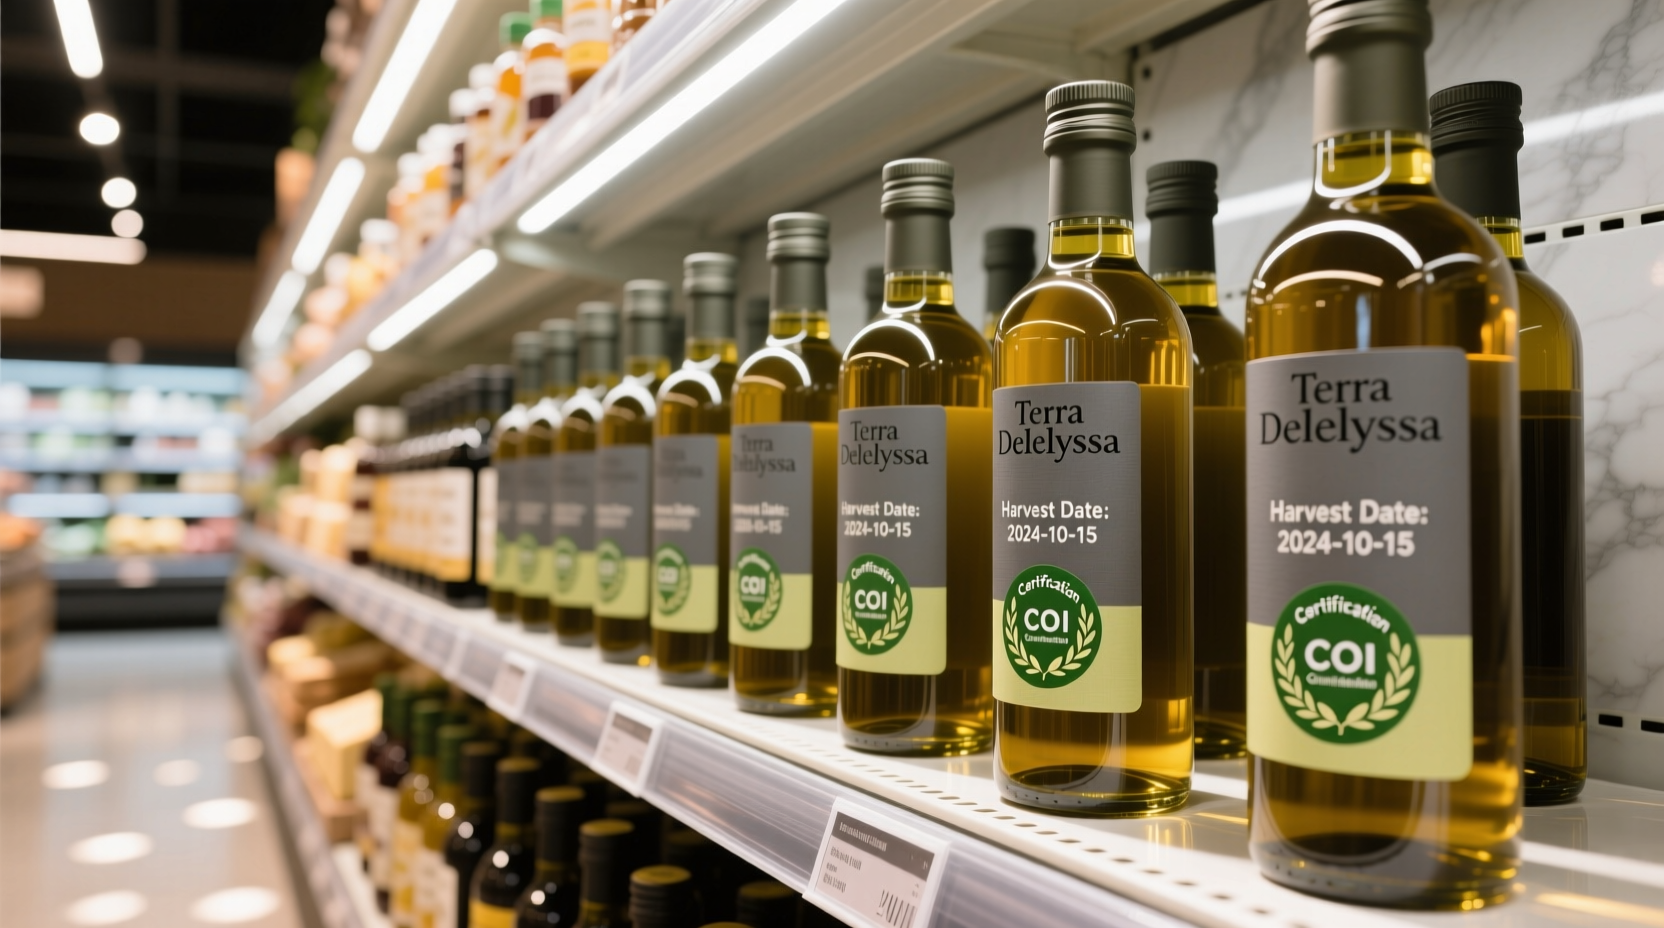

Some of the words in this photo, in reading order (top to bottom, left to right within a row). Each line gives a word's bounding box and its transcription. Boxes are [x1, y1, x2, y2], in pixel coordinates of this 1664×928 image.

[1291, 372, 1392, 405] Terra
[1014, 399, 1085, 426] Terra
[850, 420, 899, 442] Terra
[1260, 406, 1442, 454] Delelyssa
[841, 443, 929, 472] Delelyssa
[999, 427, 1121, 463] Delelyssa
[841, 501, 879, 516] Harvest
[883, 501, 920, 518] Date:
[1001, 500, 1055, 518] Harvest
[1061, 500, 1109, 520] Date:
[1270, 499, 1352, 524] Harvest
[1359, 499, 1429, 525] Date:
[843, 520, 912, 538] 2024-10-15
[1007, 524, 1098, 544] 2024-10-15
[1277, 529, 1415, 557] 2024-10-15
[854, 589, 887, 610] COI
[1023, 608, 1069, 633] COI
[1304, 638, 1376, 675] COI
